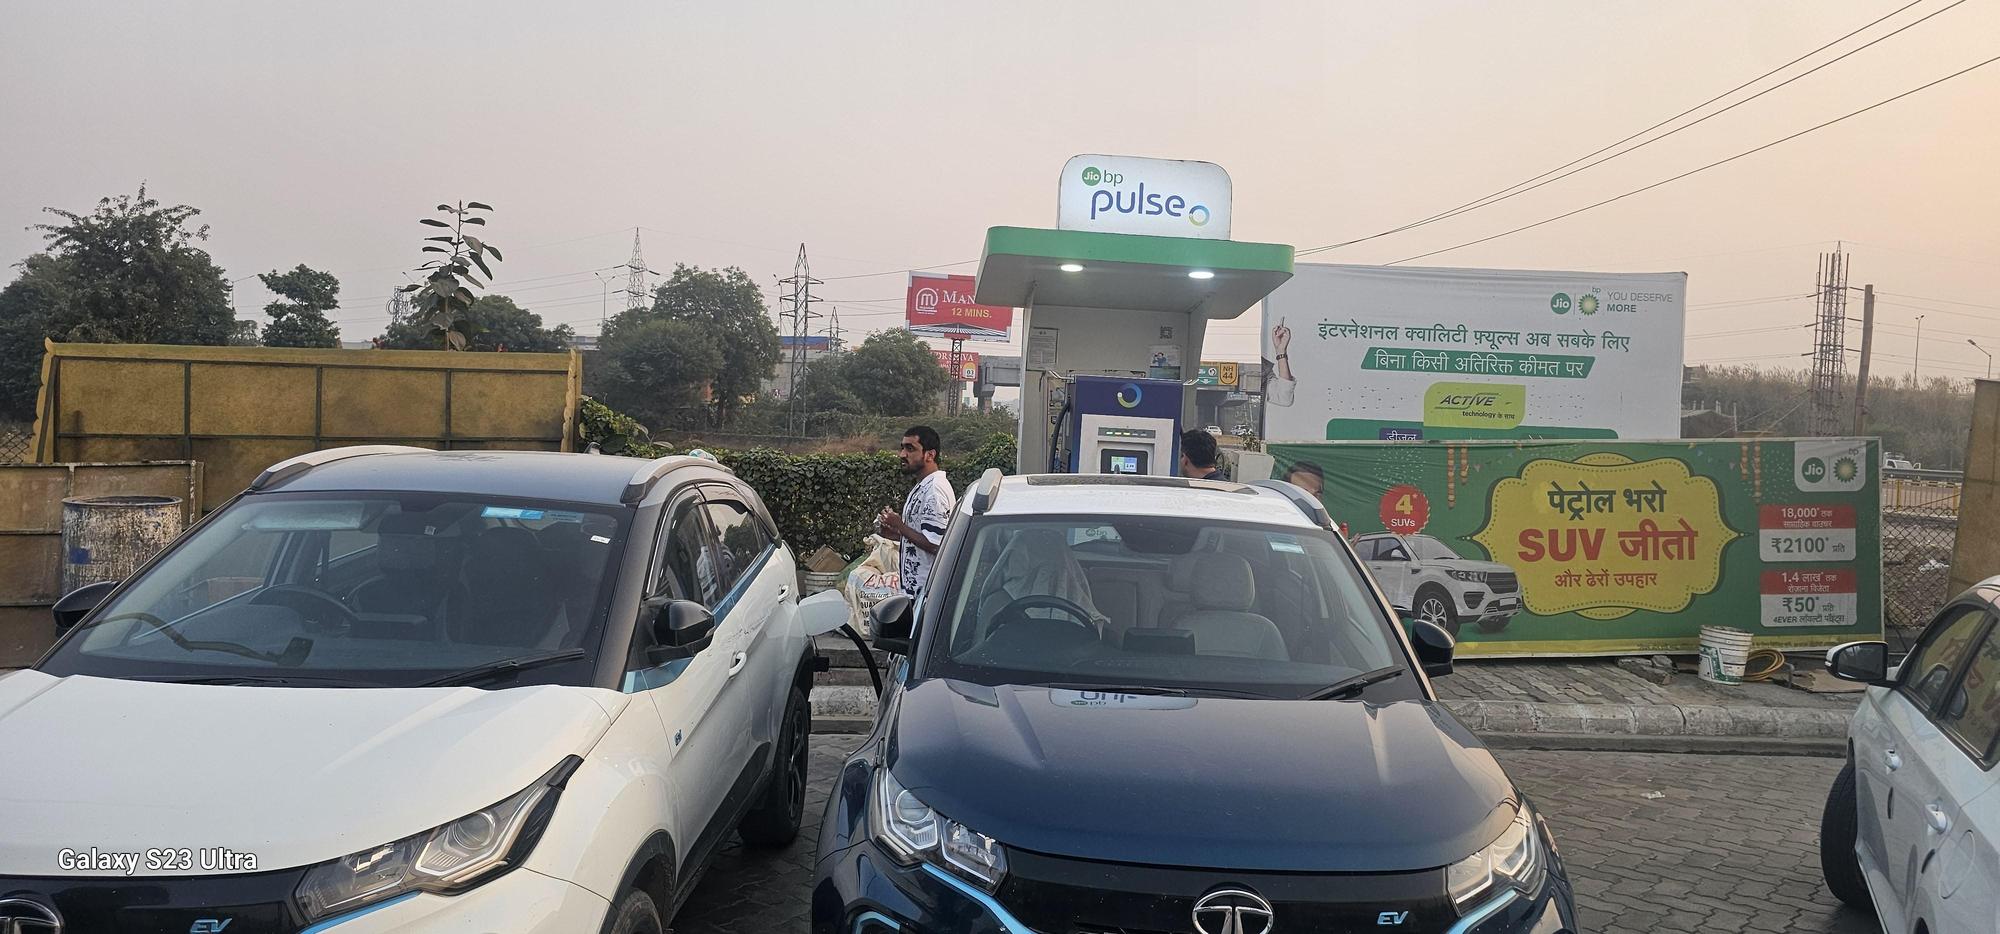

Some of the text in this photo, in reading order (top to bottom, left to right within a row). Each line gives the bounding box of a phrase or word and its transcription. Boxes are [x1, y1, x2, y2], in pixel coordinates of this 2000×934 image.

[1103, 169, 1123, 187] bp
[1090, 182, 1185, 220] pulse
[1607, 291, 1673, 303] YOU DESERVE
[951, 307, 992, 319] 12 MINS.
[1607, 303, 1637, 313] MORE
[1318, 318, 1399, 340] इंटरनेशनल
[1405, 323, 1468, 343] क्वालिटी
[1526, 332, 1551, 347] अब
[1557, 329, 1596, 349] सबके
[1601, 330, 1631, 352] लिए
[1374, 349, 1585, 376] बिना किसी अतिरिक्त कीमत पर
[1440, 394, 1497, 407] ACTIVE
[1462, 410, 1496, 419] technology
[1804, 463, 1824, 476] Jio
[1547, 480, 1667, 521] पेट्रोल भरो
[1391, 518, 1416, 527] SUVs
[1518, 518, 1699, 562] SUV जीतो
[1555, 568, 1658, 589] और ढेरों उपहार
[1781, 571, 1799, 582] 1.4
[1773, 616, 1797, 624] 4EVER
[1377, 911, 1408, 925] EV
[190, 918, 232, 933] EV
